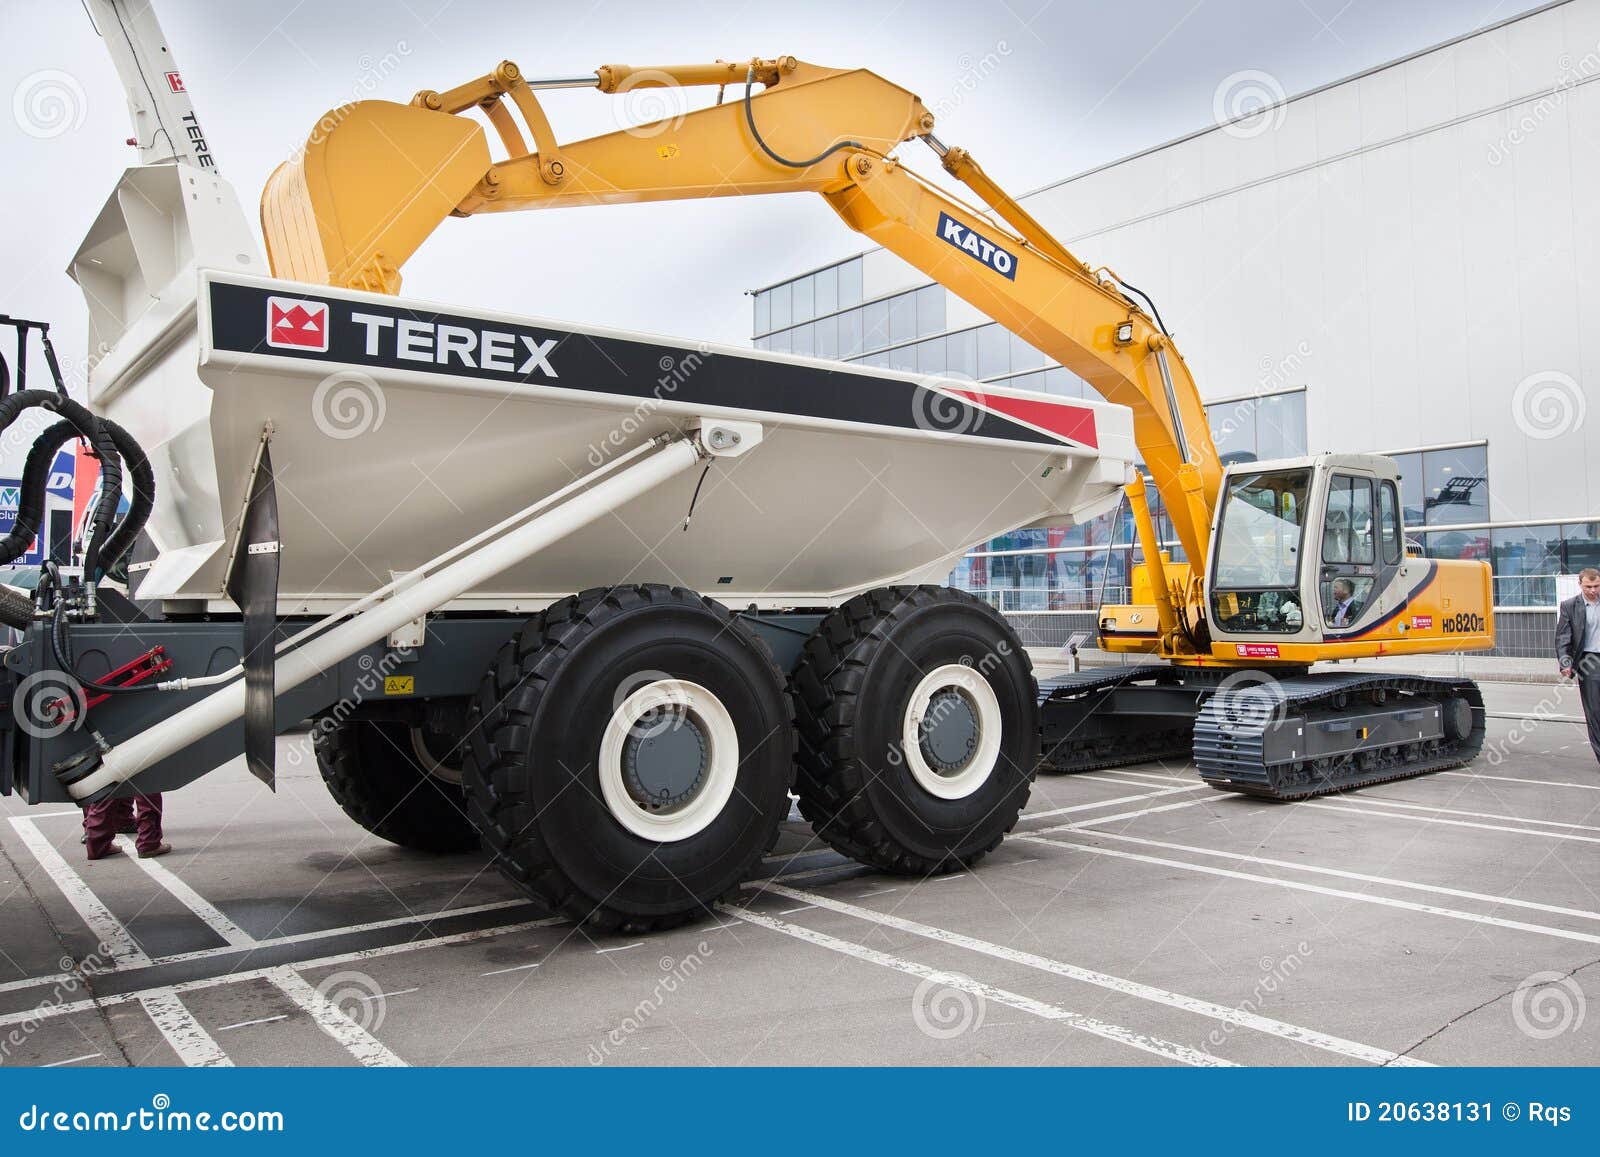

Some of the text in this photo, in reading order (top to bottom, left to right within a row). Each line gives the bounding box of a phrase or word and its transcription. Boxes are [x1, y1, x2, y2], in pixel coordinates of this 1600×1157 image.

[182, 110, 216, 172] TERE
[944, 218, 1011, 273] KATO
[351, 312, 559, 378] TEREX
